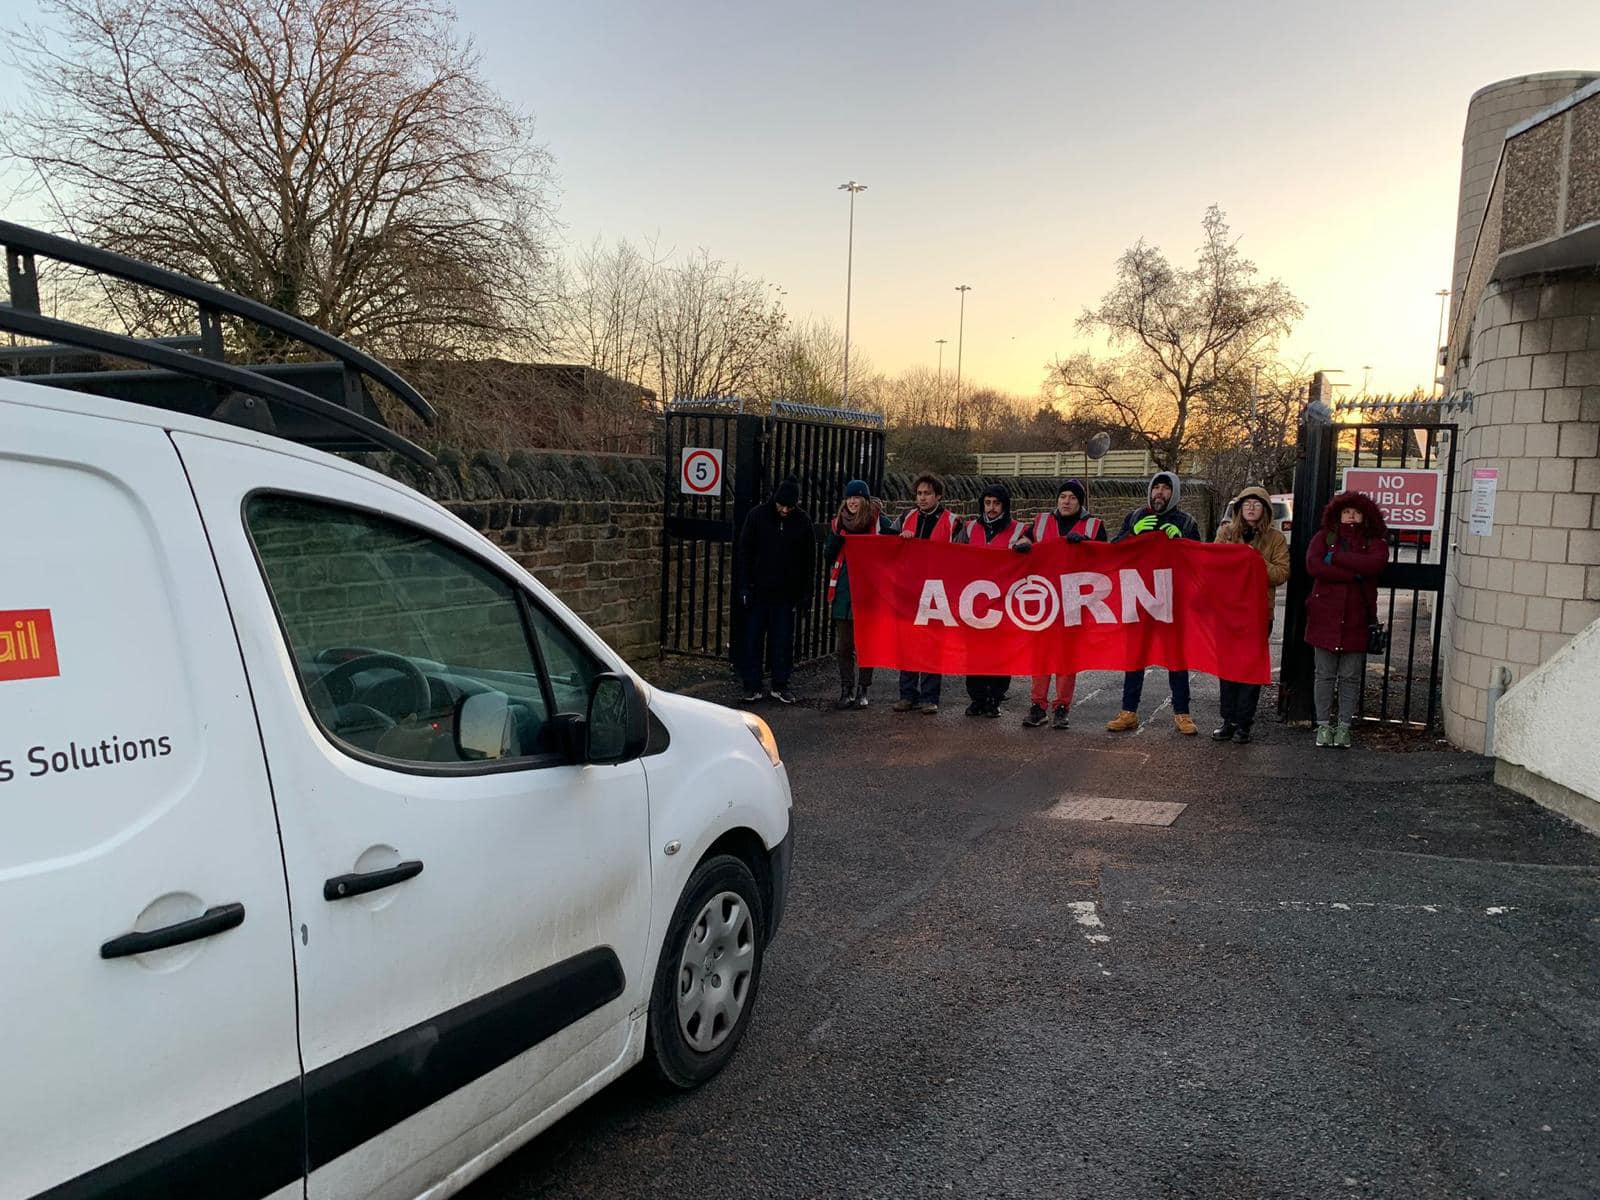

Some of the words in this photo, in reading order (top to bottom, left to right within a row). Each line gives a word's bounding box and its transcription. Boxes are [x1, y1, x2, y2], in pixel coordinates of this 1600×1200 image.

[696, 462, 707, 481] 5
[1378, 475, 1405, 489] NO
[1380, 508, 1427, 523] CESS
[913, 568, 1174, 631] ACORN
[27, 735, 172, 777] Solutions
